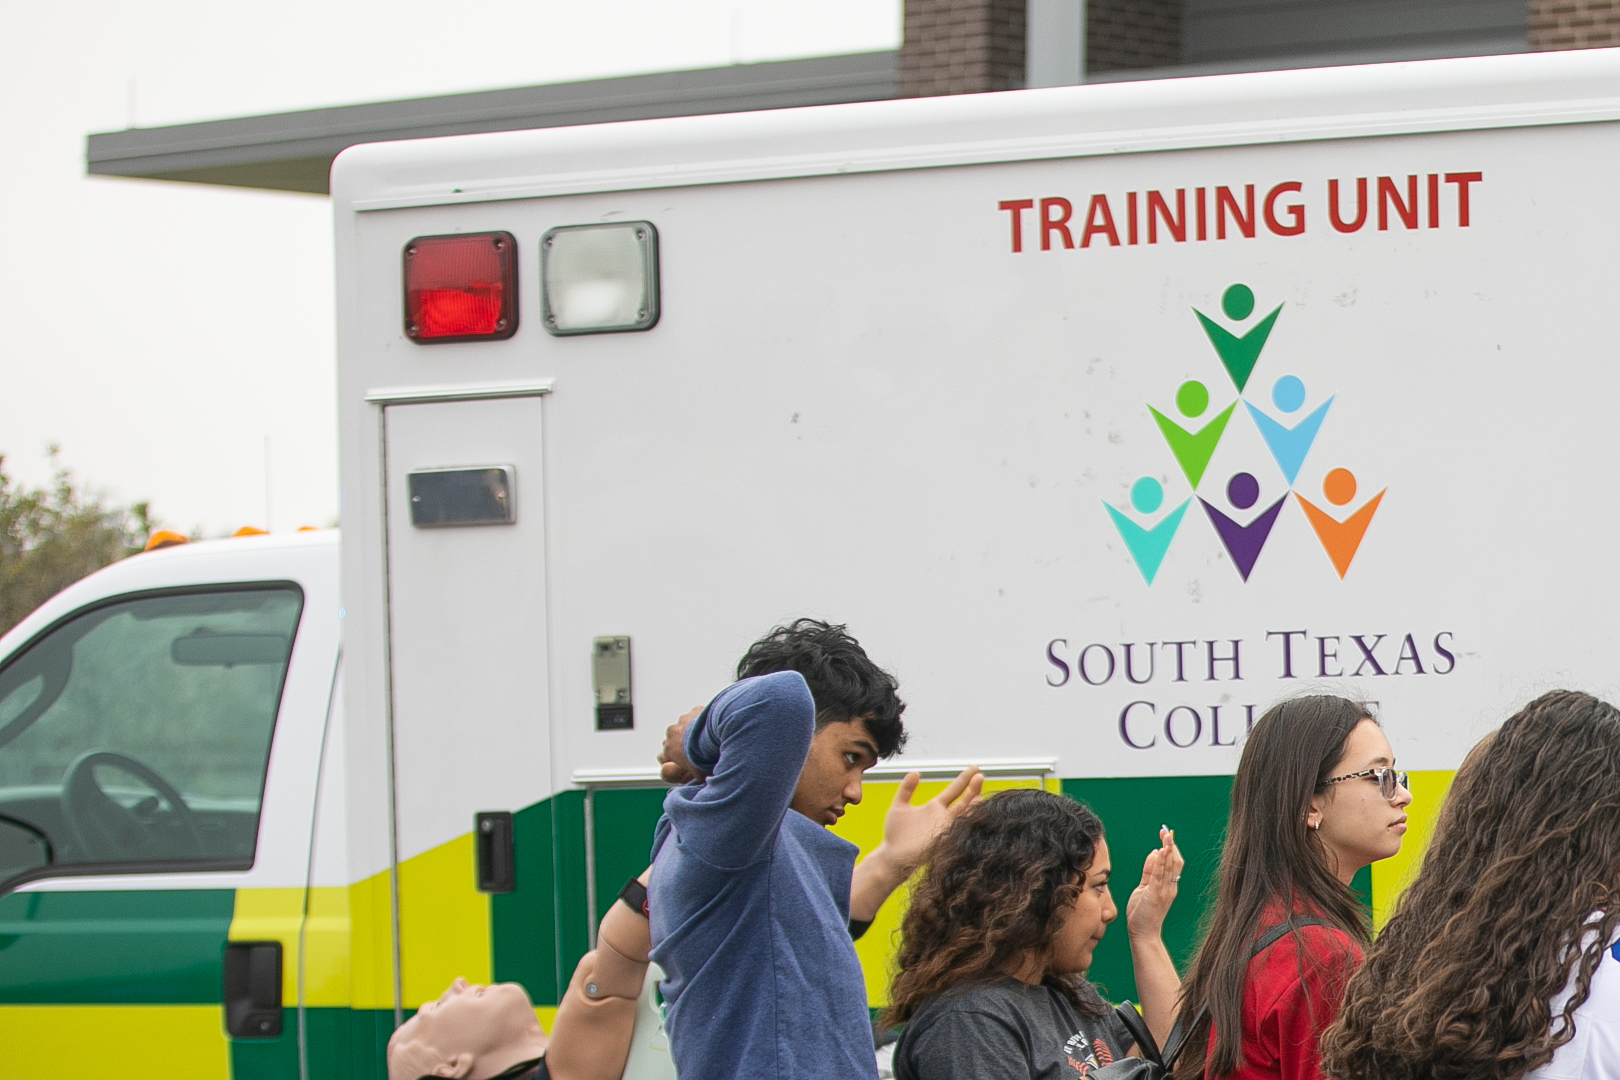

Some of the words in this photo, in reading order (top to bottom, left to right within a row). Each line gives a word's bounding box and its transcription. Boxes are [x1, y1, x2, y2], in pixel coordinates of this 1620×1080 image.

[998, 181, 1306, 253] TRAINING
[1326, 171, 1483, 234] UNIT
[1045, 638, 1244, 687] SOUTH
[1265, 628, 1456, 678] TEXAS
